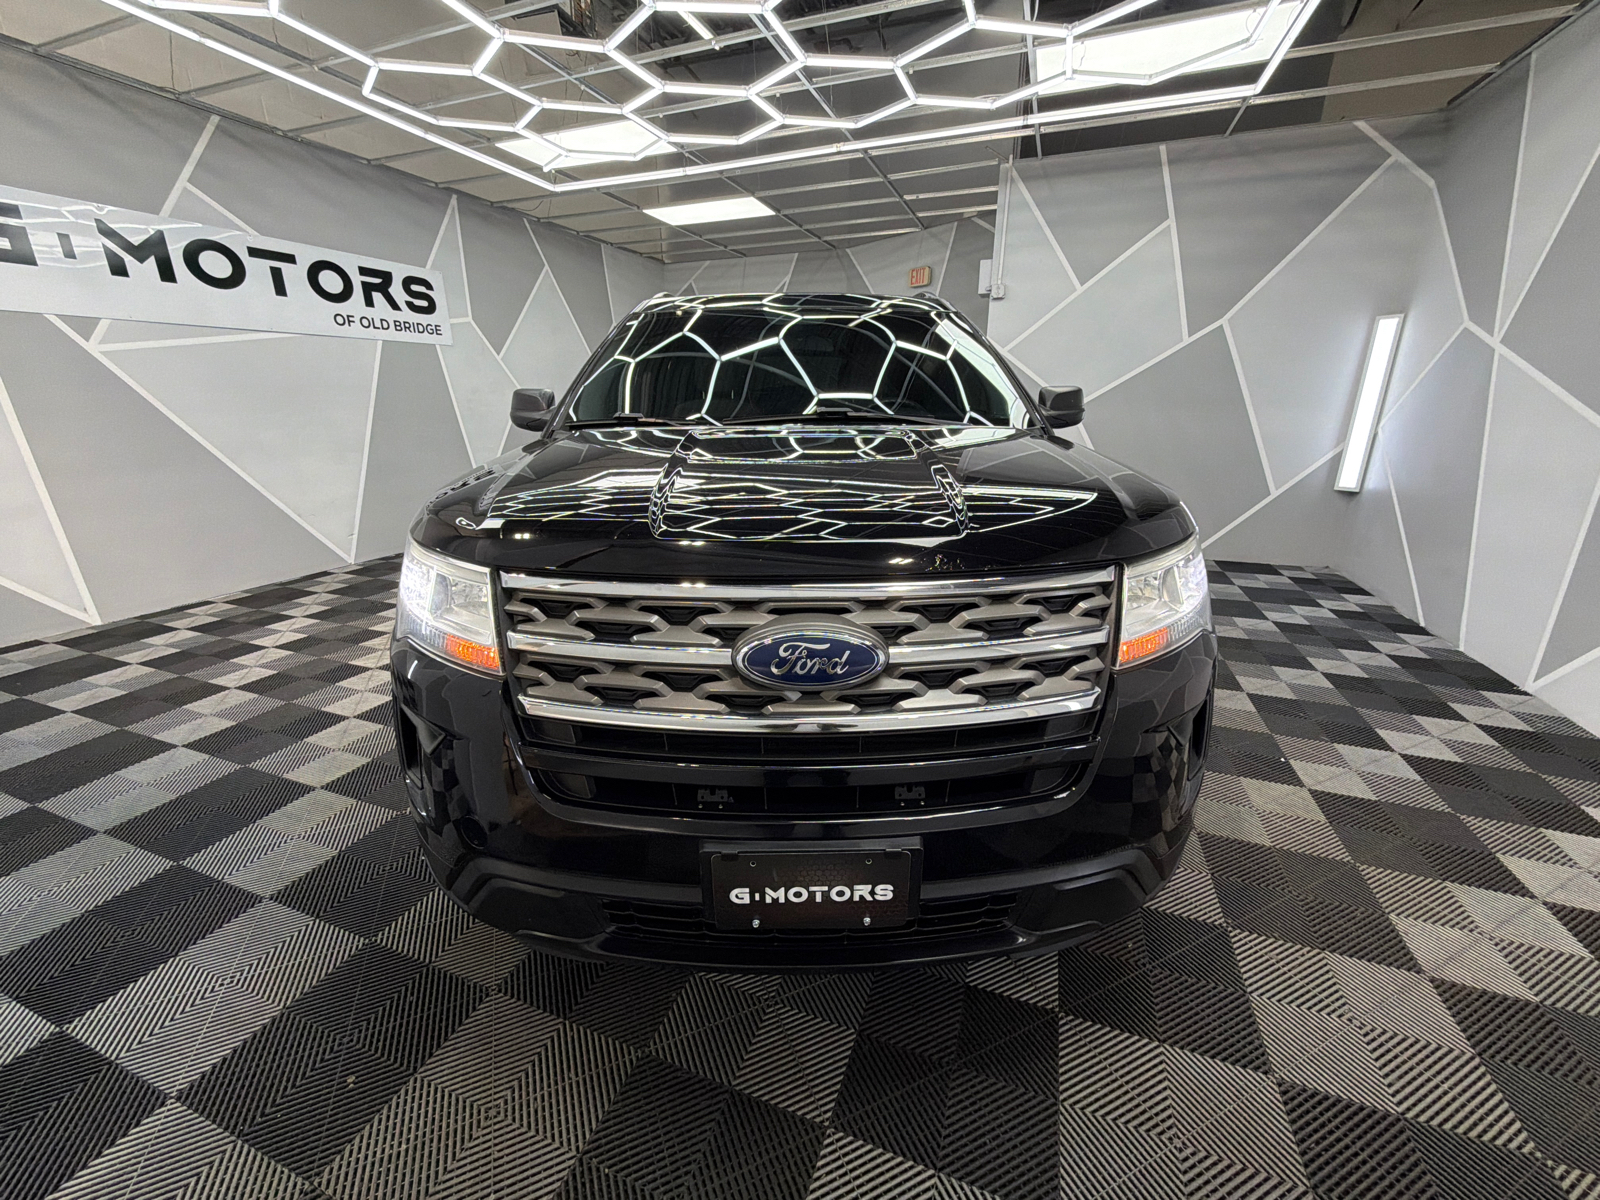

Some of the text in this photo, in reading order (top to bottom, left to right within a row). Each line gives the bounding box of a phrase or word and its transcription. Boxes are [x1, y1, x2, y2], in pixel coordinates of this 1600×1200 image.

[911, 268, 926, 285] EXIT
[333, 313, 443, 336] OF OLD BRIDGE
[770, 642, 851, 675] Ford
